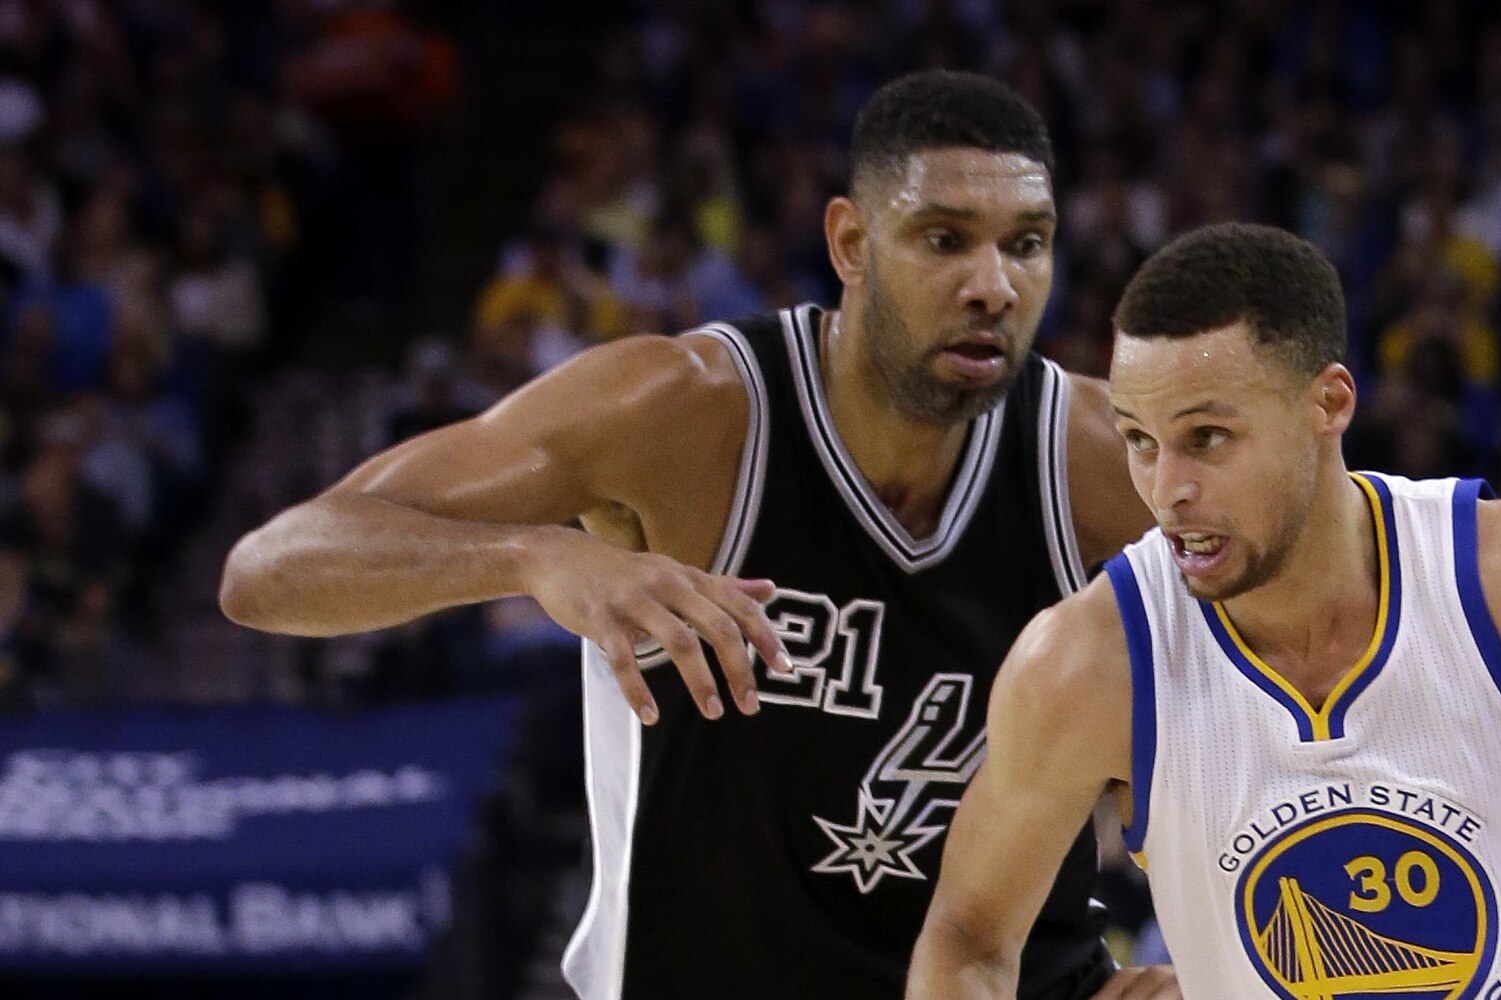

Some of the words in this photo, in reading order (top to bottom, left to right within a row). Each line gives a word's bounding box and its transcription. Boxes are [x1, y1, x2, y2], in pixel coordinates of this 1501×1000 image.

[747, 588, 885, 720] 21
[1218, 783, 1353, 873] GOLDEN
[1369, 785, 1482, 843] STATE
[1343, 850, 1441, 914] 30
